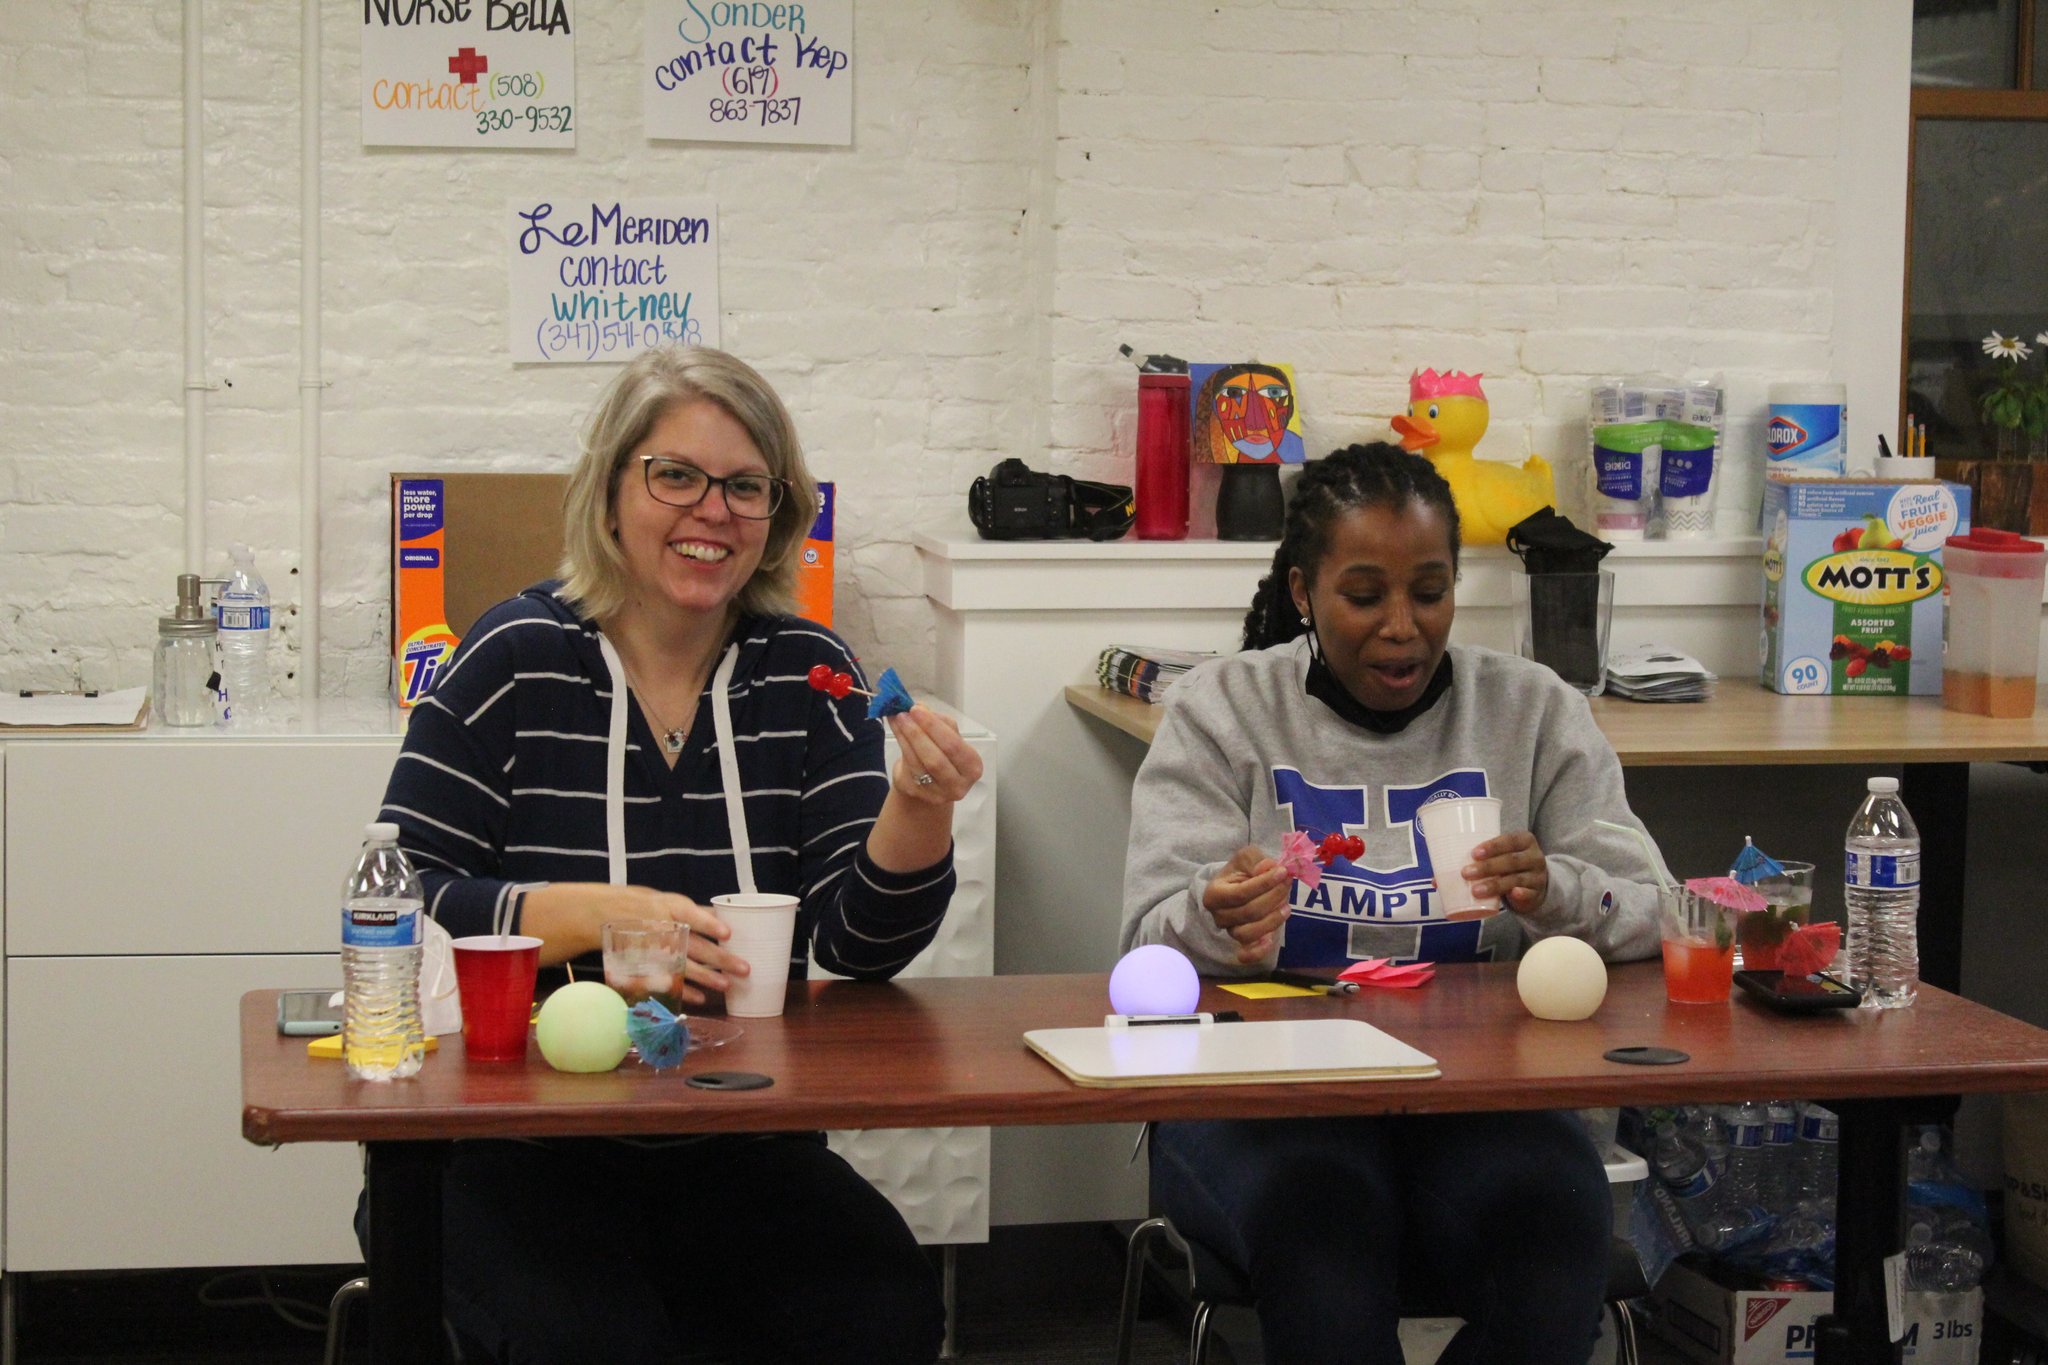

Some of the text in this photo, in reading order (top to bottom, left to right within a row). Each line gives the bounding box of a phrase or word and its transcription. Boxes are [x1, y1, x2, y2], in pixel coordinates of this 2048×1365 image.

[795, 33, 847, 78] Kep
[489, 72, 544, 100] (508)
[476, 106, 572, 134] 330-9532
[710, 97, 800, 126] 863-7837
[560, 254, 667, 287] contact
[1768, 427, 1798, 444] LOROX
[1913, 490, 1940, 504] Real
[404, 504, 436, 512] power
[1901, 503, 1939, 519] FRUIT
[1898, 511, 1947, 530] VEGGIE
[1851, 619, 1895, 627] ASSORTED
[405, 648, 444, 700] Ti
[1792, 664, 1818, 684] 90
[1289, 878, 1437, 918] AMPT
[1933, 1322, 1944, 1339] 3
[1947, 1320, 1973, 1339] lbs
